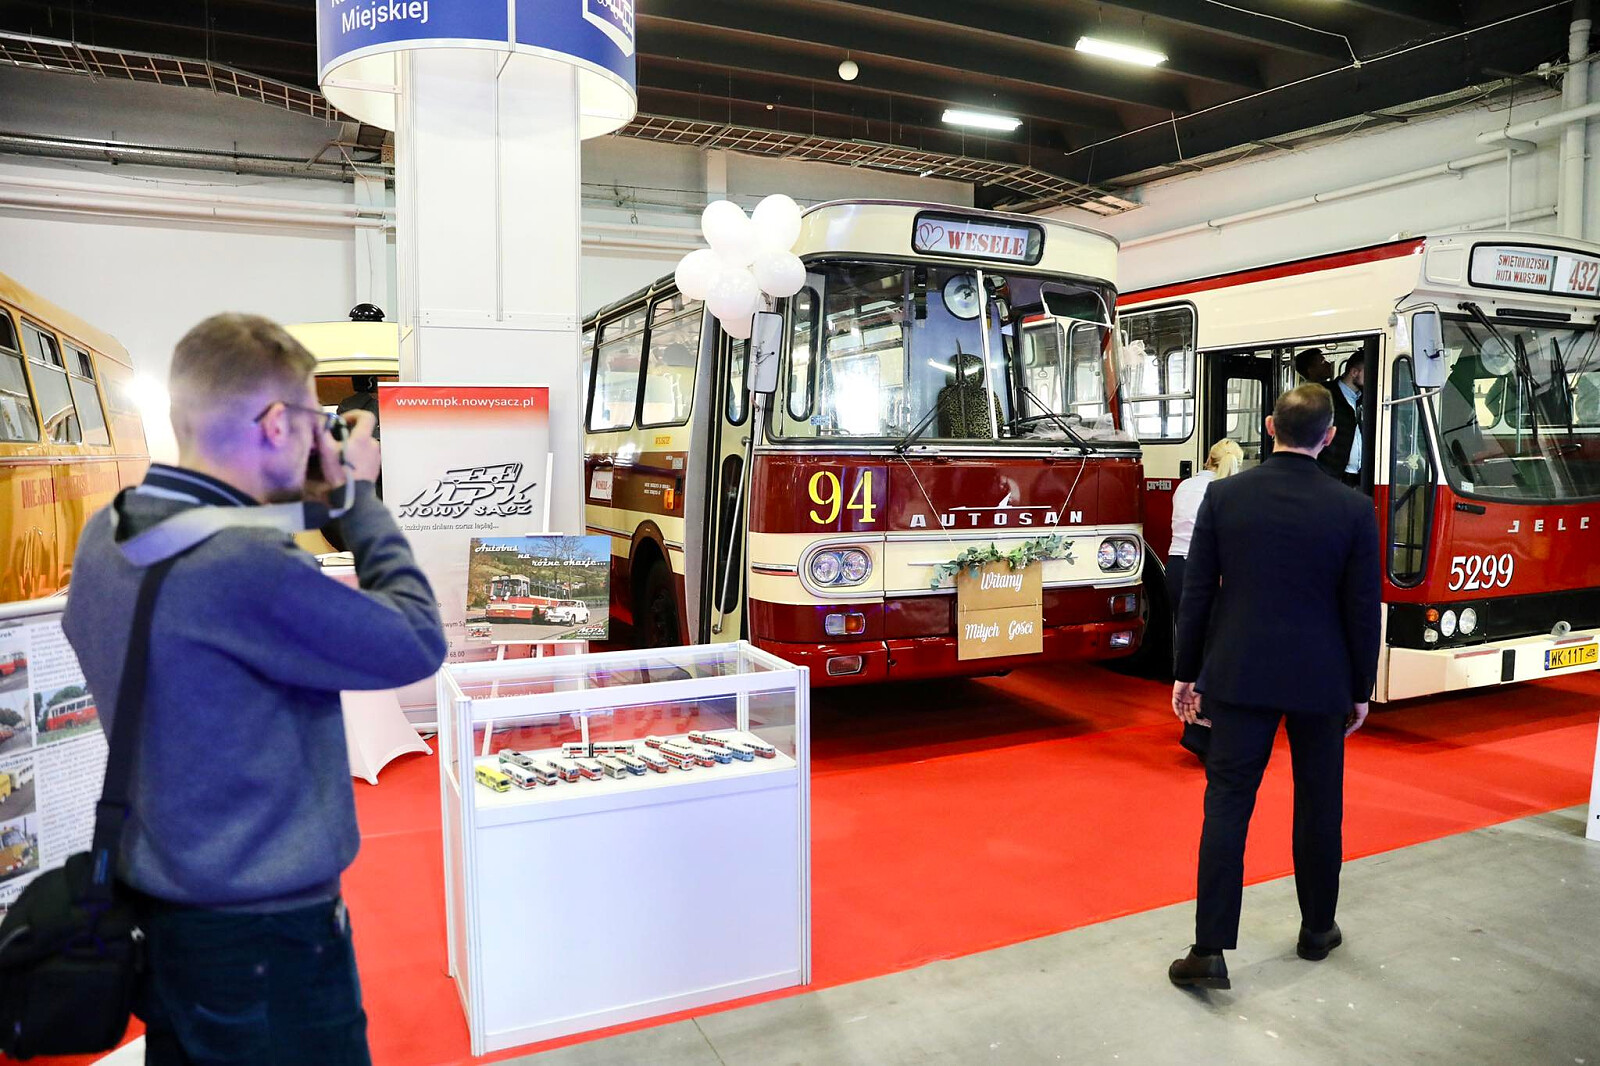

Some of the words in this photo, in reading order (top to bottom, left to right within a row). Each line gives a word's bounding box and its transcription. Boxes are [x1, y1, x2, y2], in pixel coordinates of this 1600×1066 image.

[342, 0, 429, 34] Miejskiej
[948, 231, 1025, 256] WESELE
[1496, 270, 1511, 281] HUTA
[1513, 271, 1547, 285] WARSZAWA
[1569, 261, 1598, 291] 432
[396, 396, 534, 408] www.mpk.nowysacz.pl
[400, 479, 537, 506] MPK
[808, 470, 876, 525] 94
[398, 505, 469, 519] NOWY
[909, 510, 1083, 528] AUTOSAN
[475, 543, 519, 553] Autobus
[532, 558, 560, 567] różne
[563, 557, 606, 567] okazje...
[1448, 553, 1514, 591] 5299
[981, 572, 1023, 592] Witamy
[1008, 620, 1034, 640] Gości
[1551, 651, 1564, 667] WK
[1568, 647, 1585, 664] 11T
